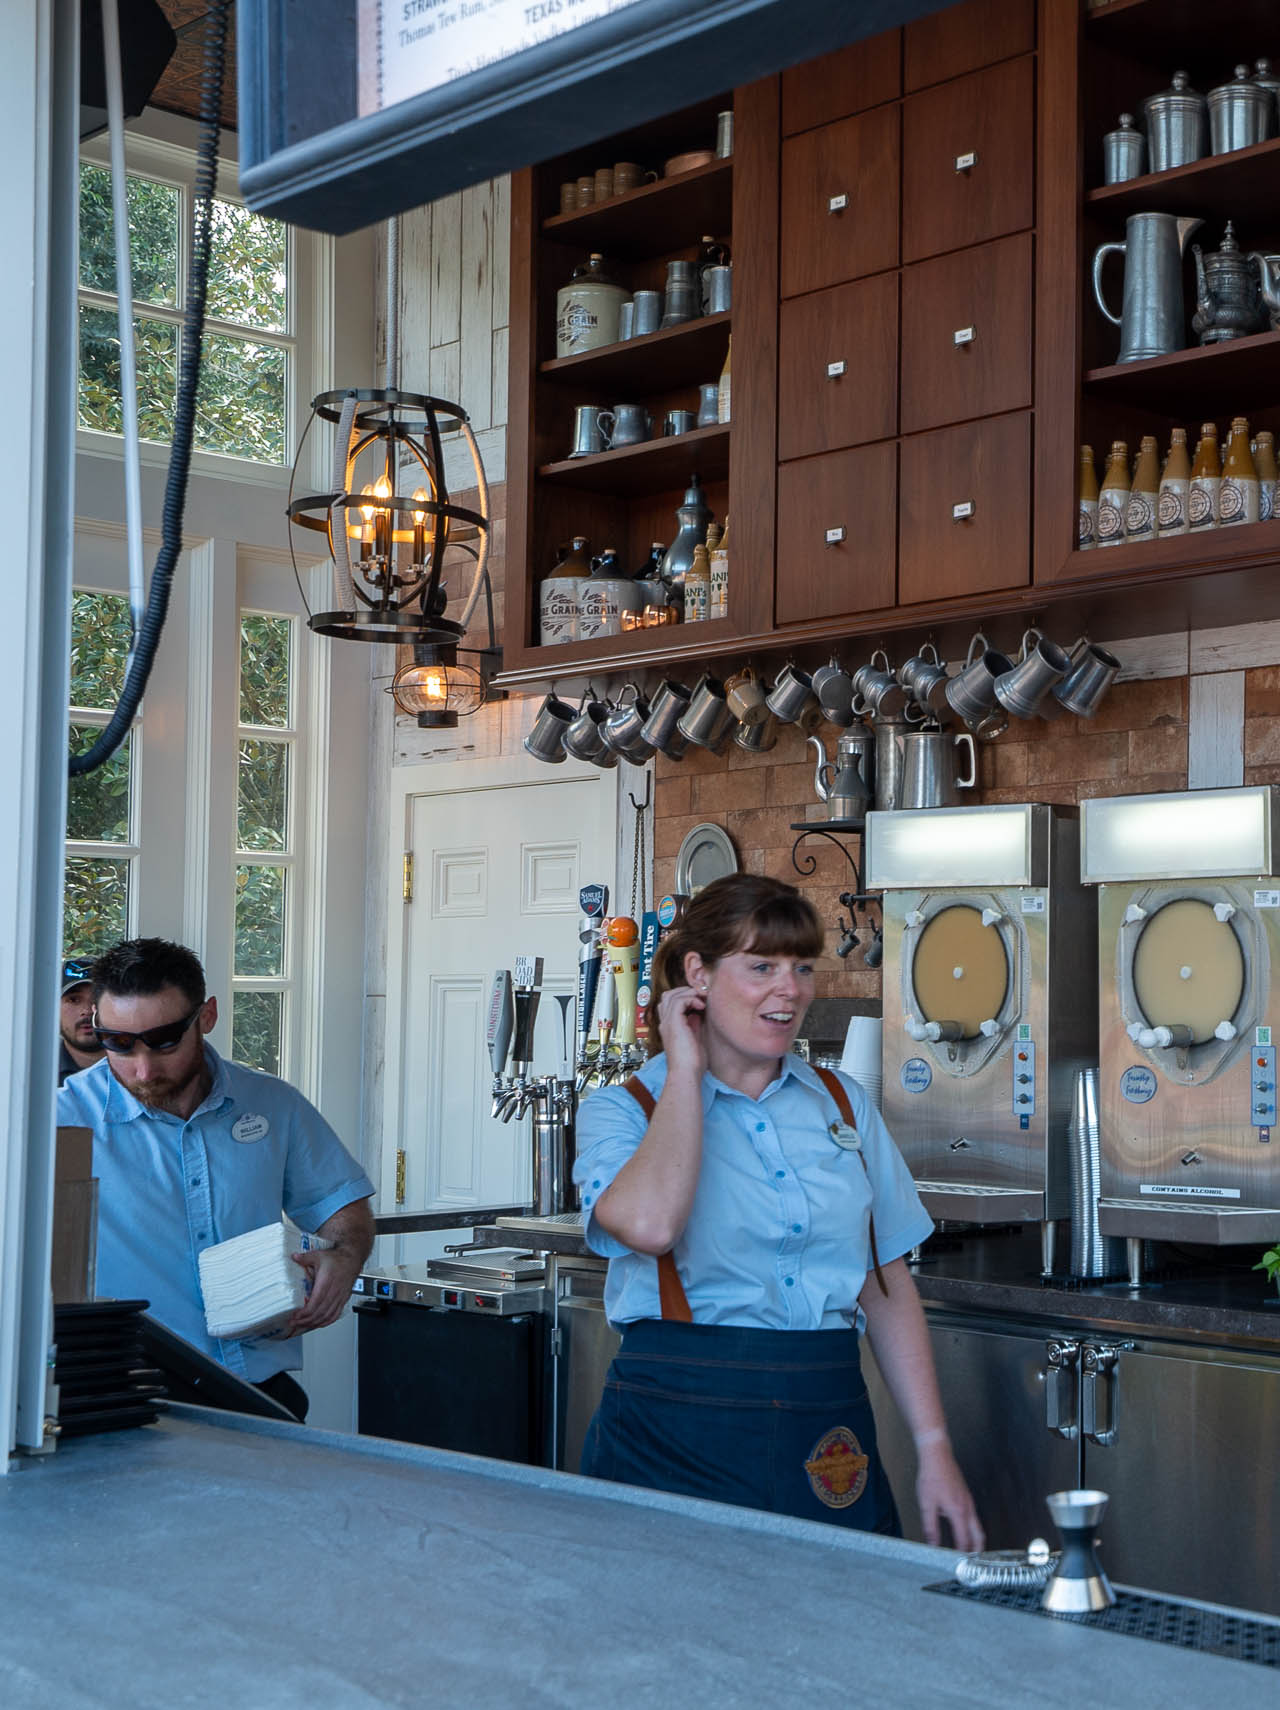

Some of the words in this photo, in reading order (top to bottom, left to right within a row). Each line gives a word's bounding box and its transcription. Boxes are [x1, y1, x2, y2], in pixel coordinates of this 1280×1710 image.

[587, 604, 618, 615] GRAIN
[580, 890, 603, 899] SAMUEL
[581, 896, 600, 904] ADAMS
[644, 924, 655, 956] Tire
[1151, 1186, 1189, 1194] CONTAINS
[1190, 1187, 1224, 1196] ALCOHOL
